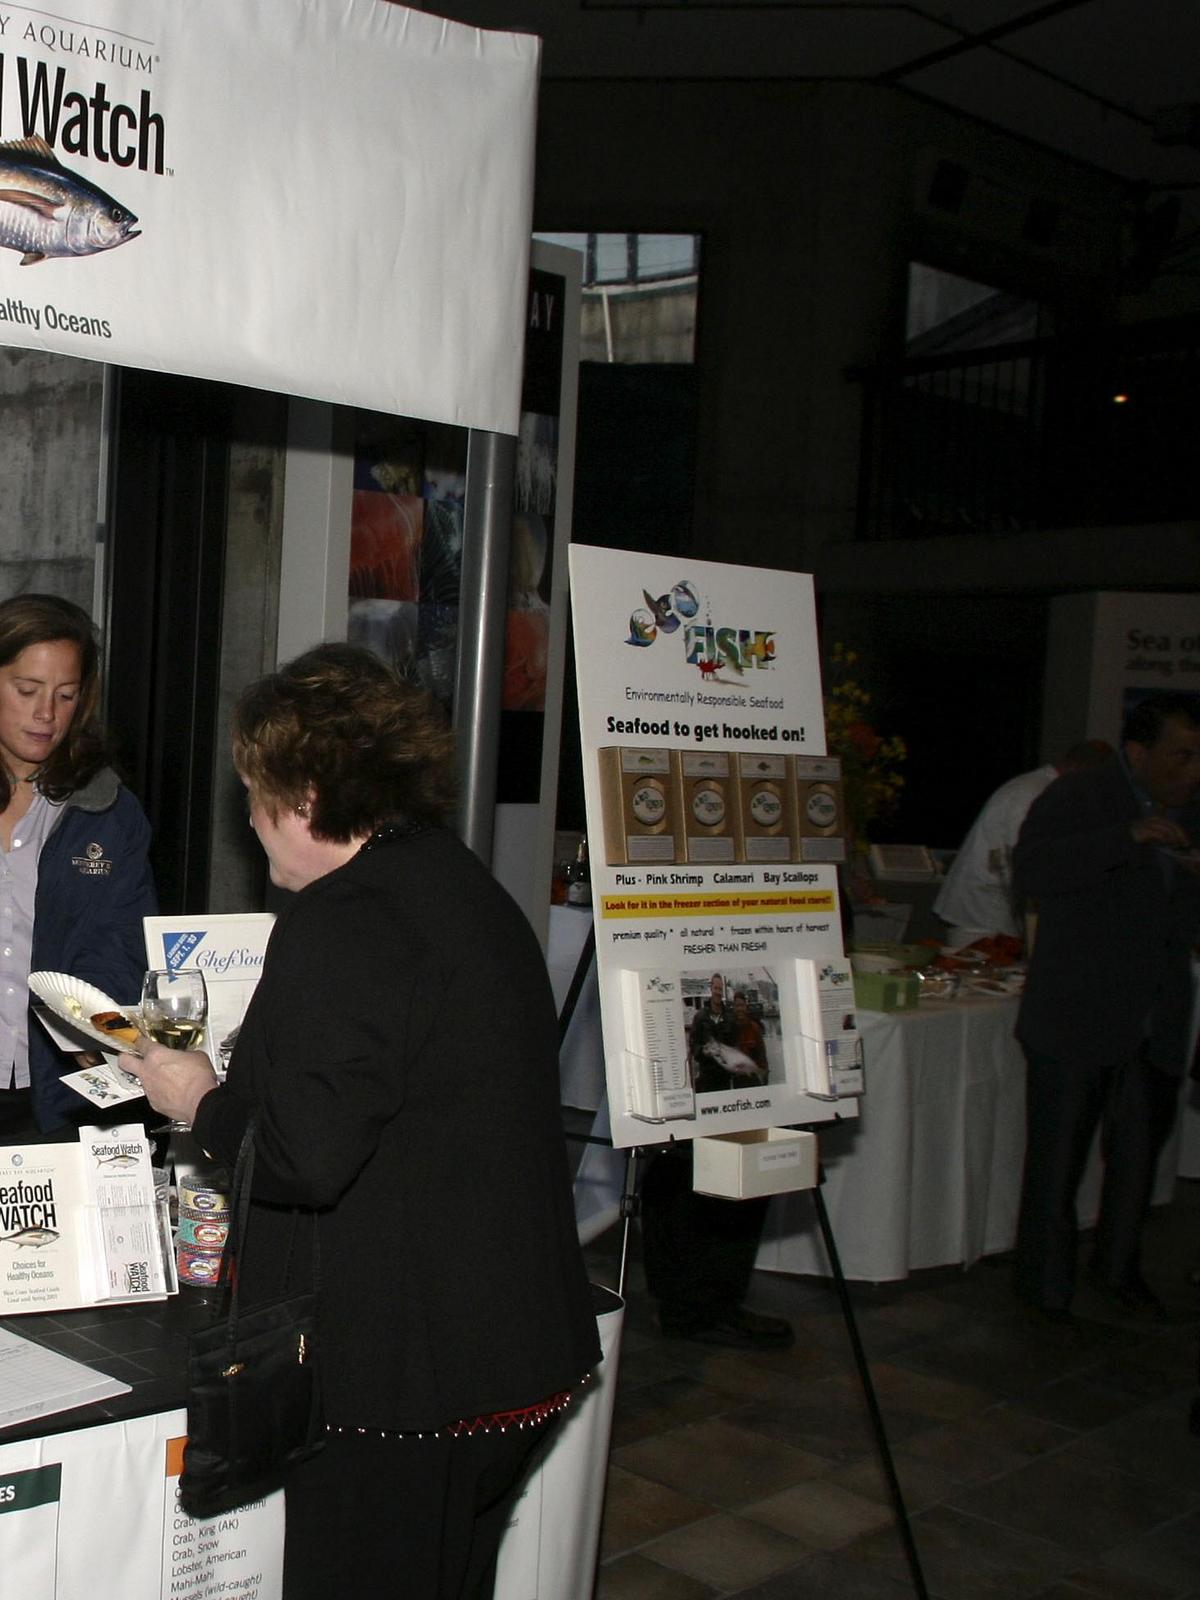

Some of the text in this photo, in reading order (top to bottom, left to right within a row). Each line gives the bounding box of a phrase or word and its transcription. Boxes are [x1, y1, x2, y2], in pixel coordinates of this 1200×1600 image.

[16, 55, 166, 176] Watch
[44, 304, 113, 339] Oceans
[1127, 629, 1170, 651] Sea
[625, 687, 784, 709] Environmentally Responsible Seafood
[607, 716, 805, 742] Seafood to get hooked on!
[646, 873, 668, 885] Pink
[670, 872, 704, 887] Shrimp
[713, 872, 754, 884] Calamari
[763, 872, 781, 886] Bay
[782, 872, 819, 885] Scallops
[605, 901, 626, 910] Look
[627, 900, 640, 909] for
[641, 900, 649, 909] it
[649, 900, 657, 908] in
[658, 899, 672, 908] the
[718, 943, 740, 952] THAN
[700, 1098, 772, 1116] www.ecofish.com
[91, 1143, 143, 1156] Seafood Watch
[7, 1270, 54, 1281] Healthy Oceans
[12, 1260, 46, 1270] Choices for
[129, 1262, 141, 1293] WATCH
[172, 1518, 239, 1546] Crab, King (AK)
[173, 1517, 197, 1530] Crab,
[171, 1540, 220, 1562] Crab, Snow
[171, 1548, 247, 1578] Lobster, American
[170, 1568, 215, 1593] Mahi-Mahi
[204, 1573, 263, 1598] (wild-caught)
